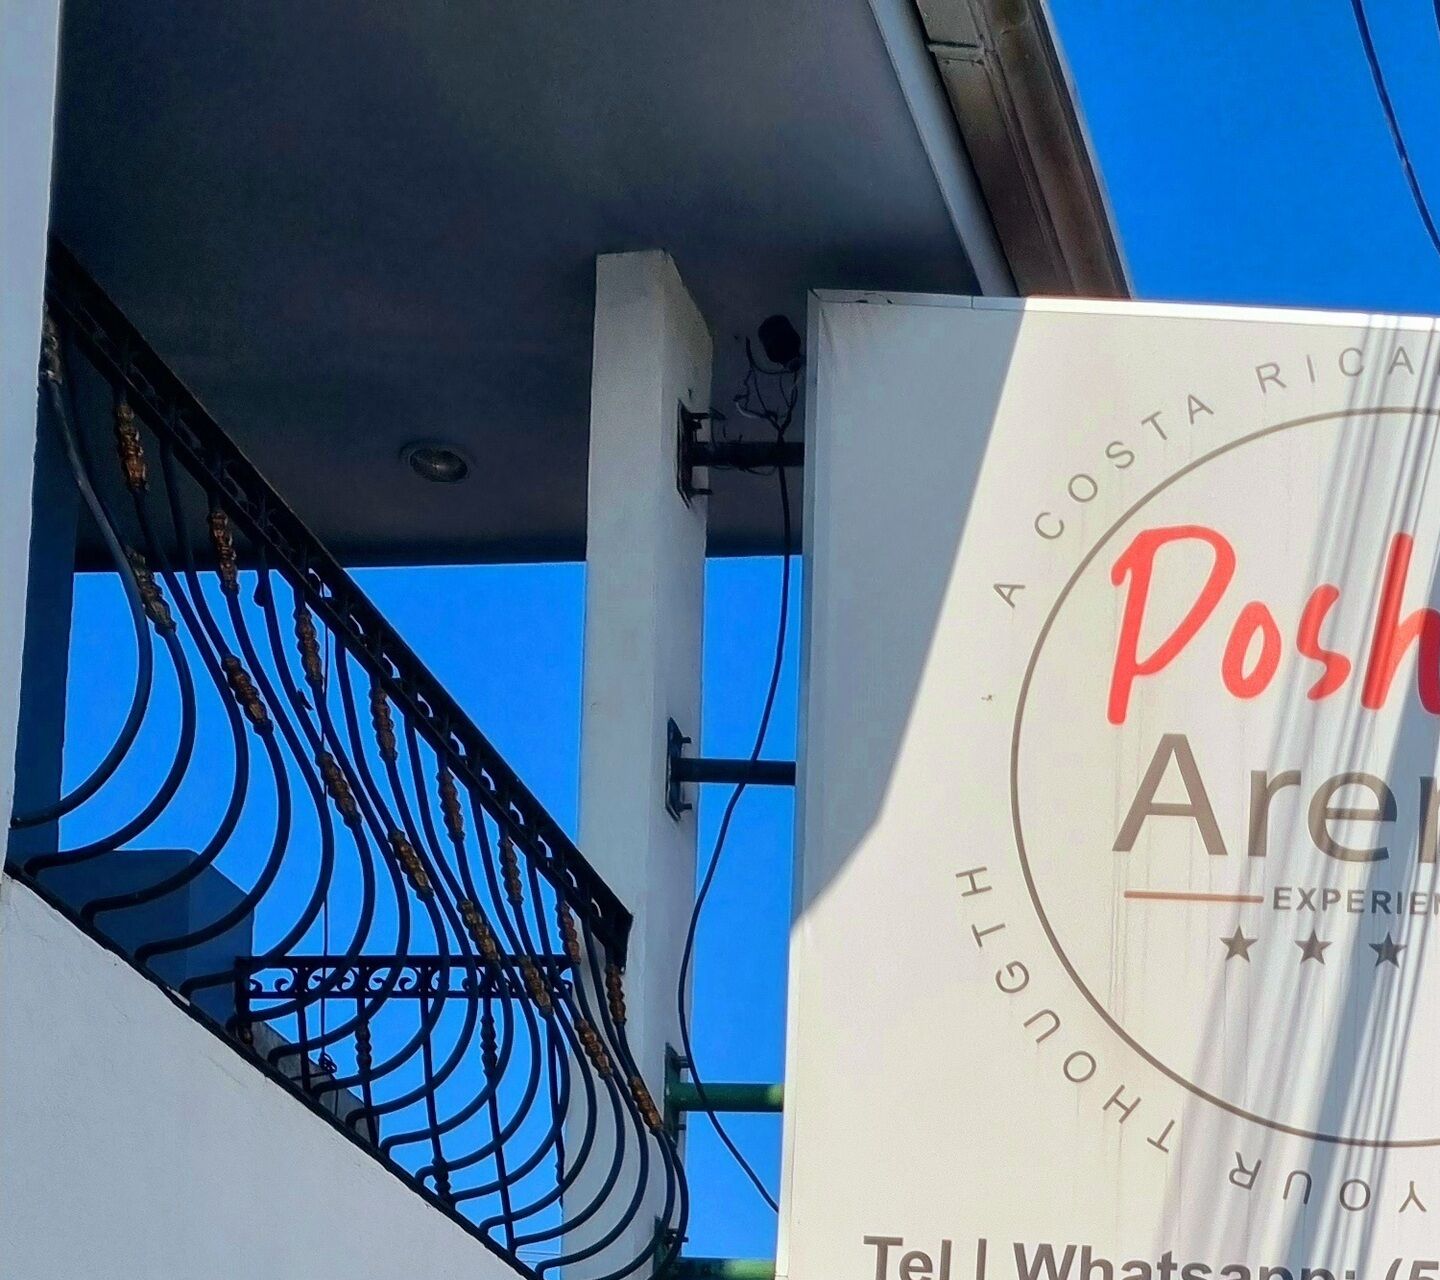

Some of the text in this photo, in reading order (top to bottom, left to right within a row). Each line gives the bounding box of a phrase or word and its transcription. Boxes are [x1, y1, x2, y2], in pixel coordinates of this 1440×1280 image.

[993, 578, 1026, 609] A
[1034, 393, 1213, 543] COSTA
[956, 865, 1178, 1154] THOUGTH
[1228, 1150, 1427, 1214] YOUR
